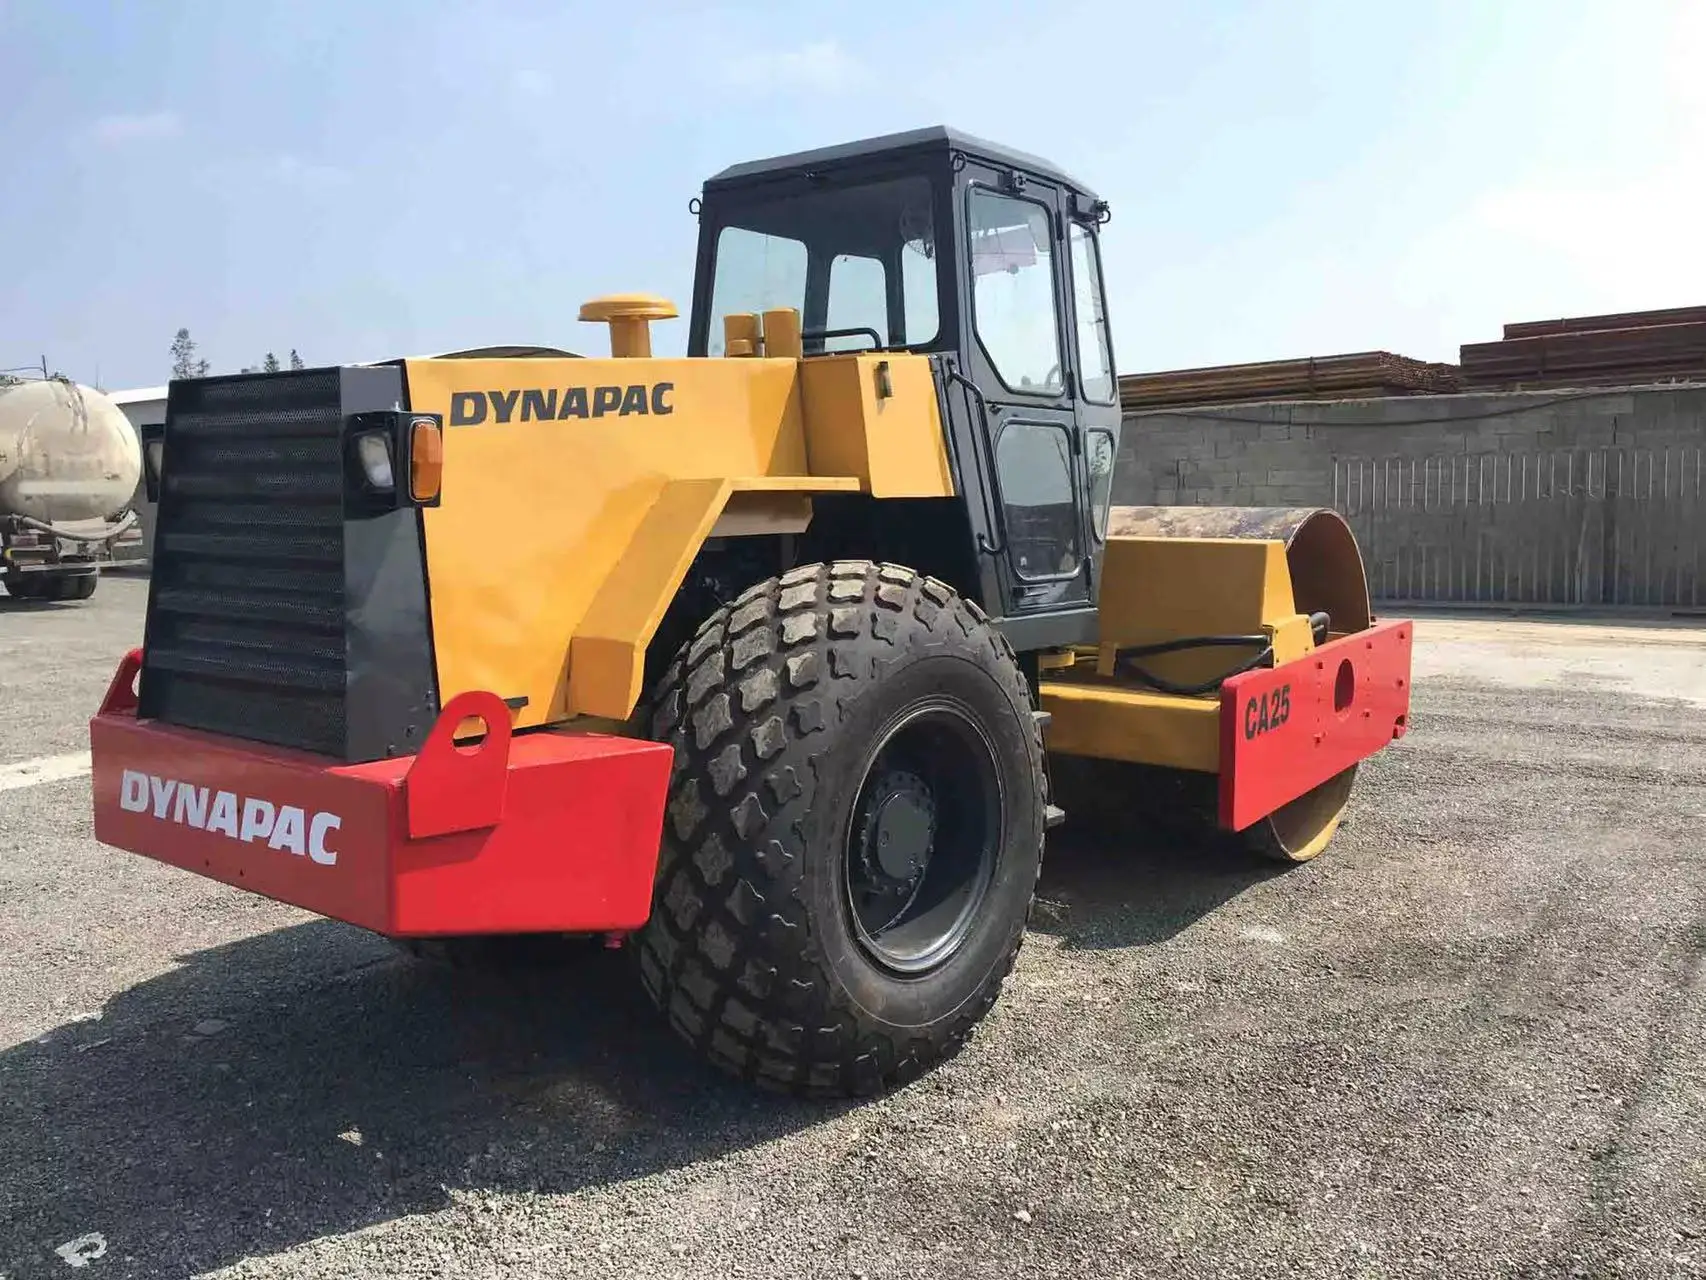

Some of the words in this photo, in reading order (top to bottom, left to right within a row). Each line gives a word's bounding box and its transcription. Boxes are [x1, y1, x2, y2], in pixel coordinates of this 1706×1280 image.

[451, 382, 674, 426] DYNAPAC
[1245, 685, 1291, 740] CA25
[120, 769, 342, 866] DYNAPAC
